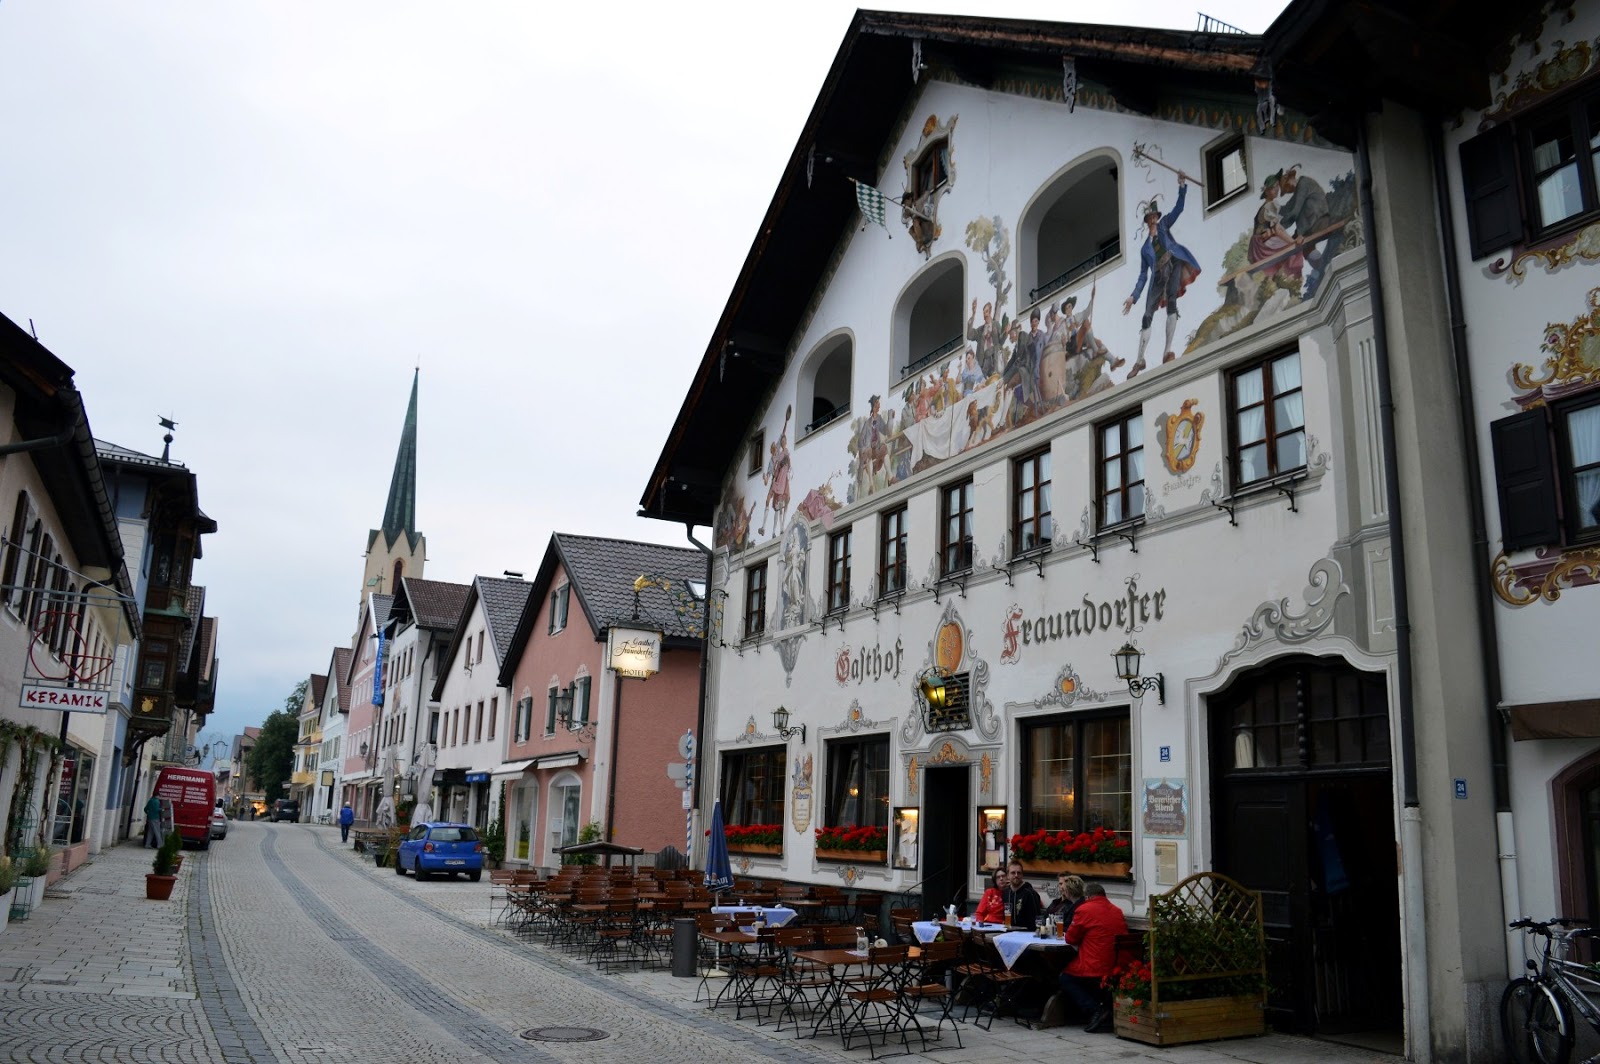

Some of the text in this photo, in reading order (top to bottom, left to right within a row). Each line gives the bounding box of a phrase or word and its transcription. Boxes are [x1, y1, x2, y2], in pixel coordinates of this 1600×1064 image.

[835, 573, 1167, 687] Gasthof Fraundorfer
[630, 637, 655, 649] Gasthof
[26, 690, 103, 708] KERAMIK
[167, 774, 206, 784] HERRMANN
[1555, 977, 1586, 1013] HERCULES
